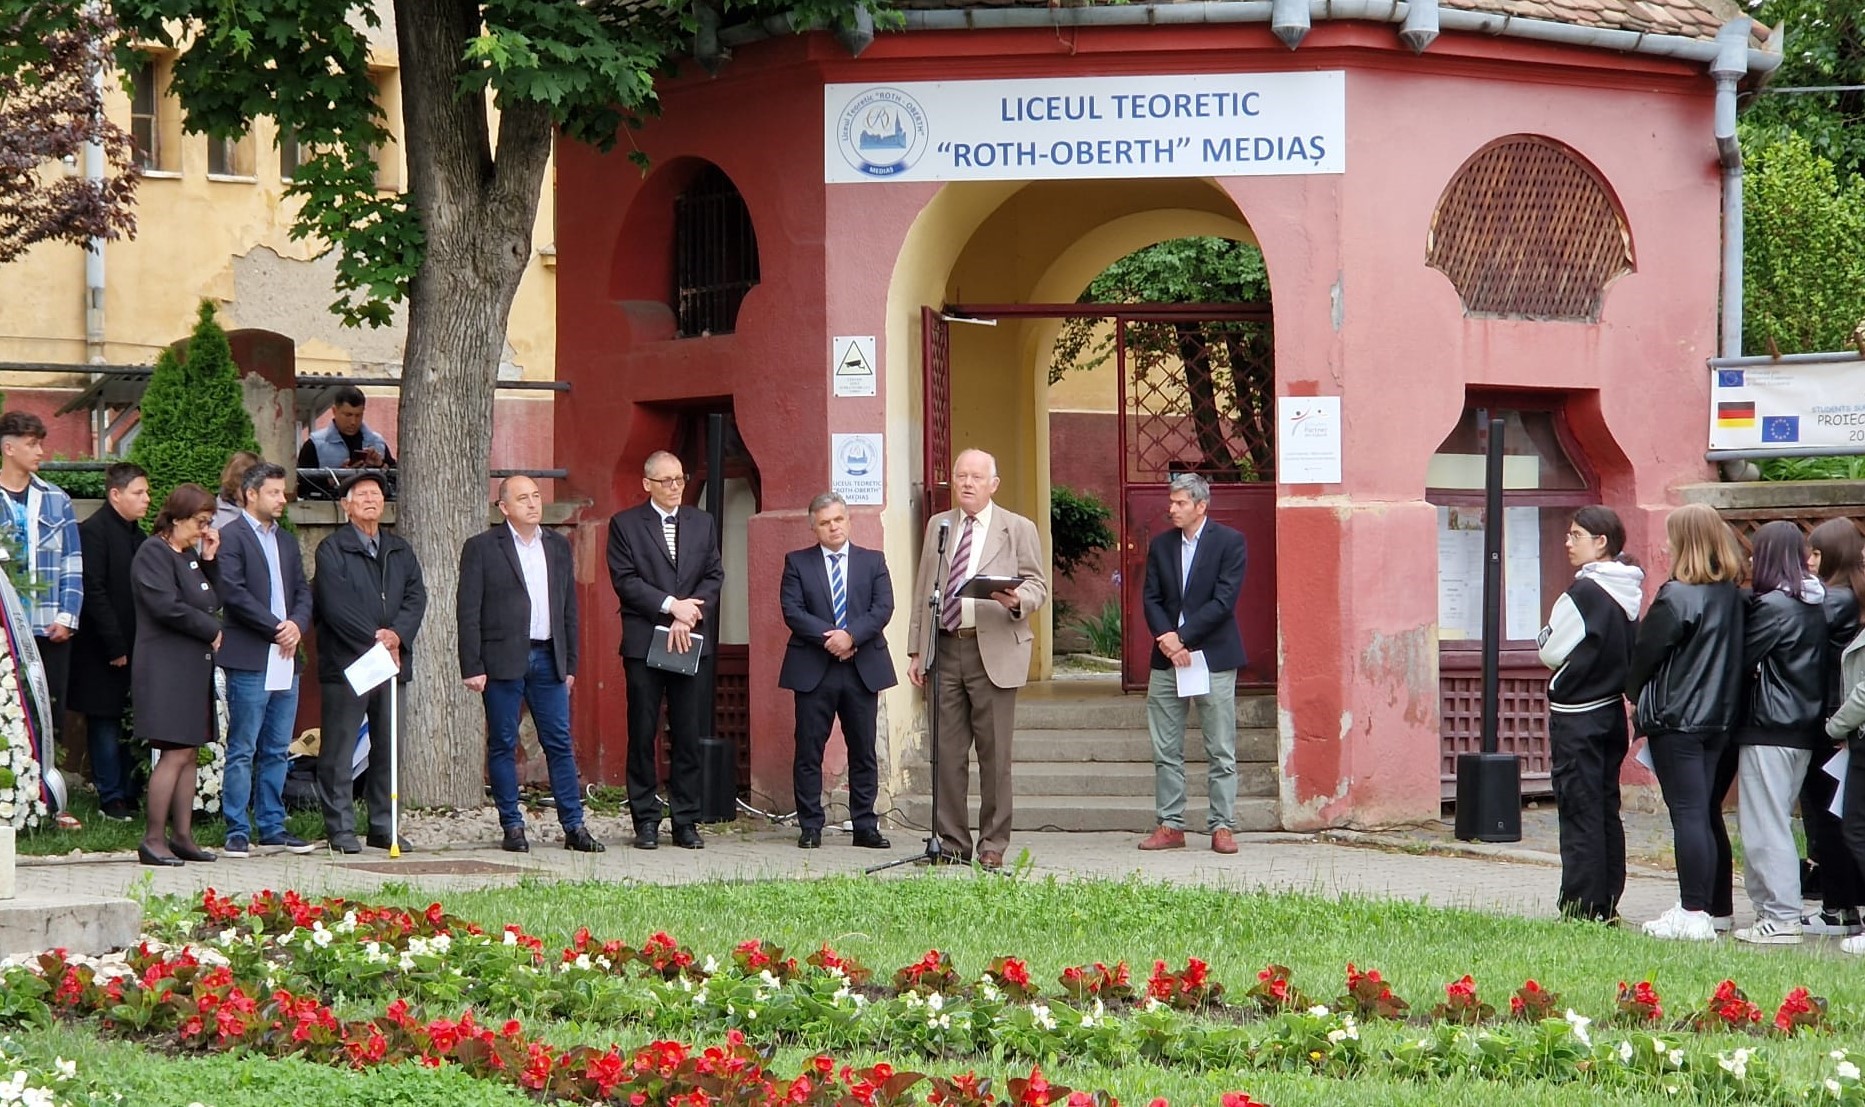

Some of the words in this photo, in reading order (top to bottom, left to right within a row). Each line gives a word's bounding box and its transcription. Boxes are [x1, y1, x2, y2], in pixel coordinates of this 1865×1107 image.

[1000, 96, 1102, 122] LICEUL
[1111, 91, 1261, 119] TEORETIC
[936, 137, 1191, 168] “ROTH-OBERTH”
[1202, 135, 1326, 167] MEDIAȘ
